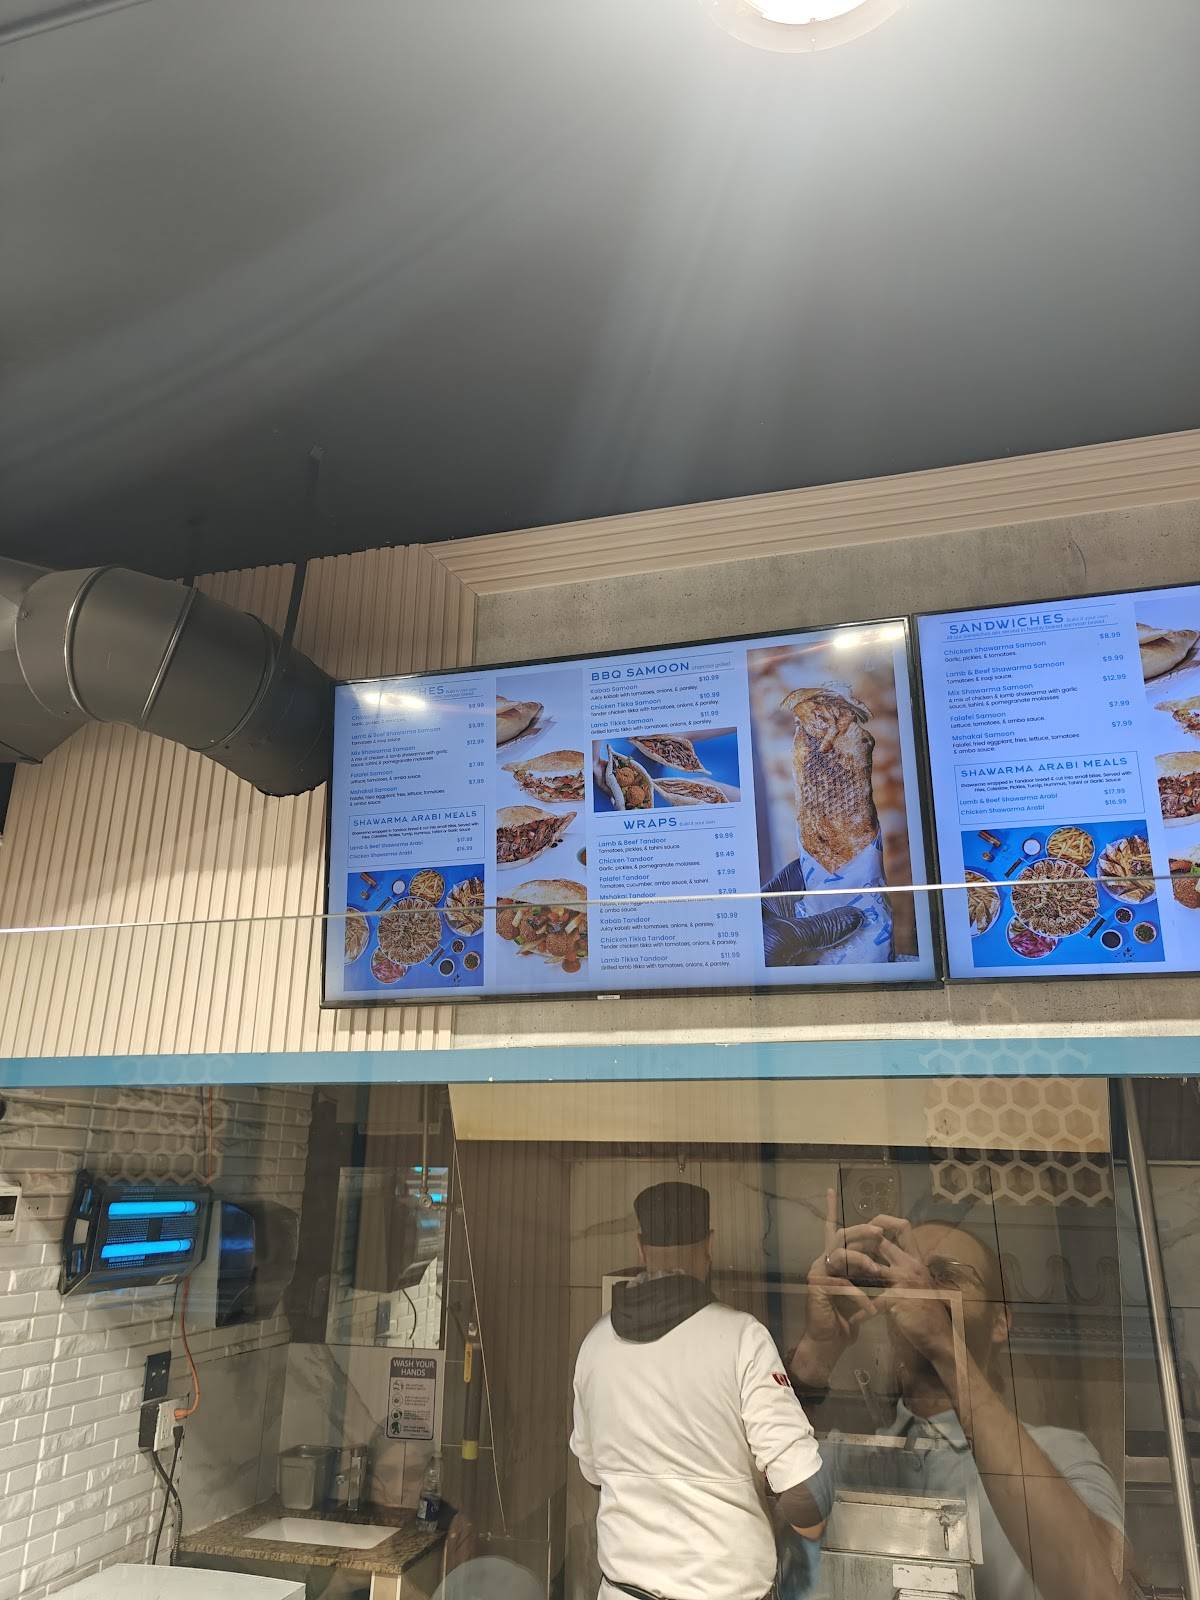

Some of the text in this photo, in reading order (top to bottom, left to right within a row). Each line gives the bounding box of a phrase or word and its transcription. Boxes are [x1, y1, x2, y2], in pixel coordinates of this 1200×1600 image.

[950, 613, 1064, 635] SANDWICHES
[591, 662, 689, 681] BBQ SAMOON
[961, 758, 1127, 777] SHAWARMA ARABI MEALS
[353, 816, 408, 827] SHAWARMA
[411, 813, 441, 822] ARABI
[445, 810, 477, 819] MEALS
[623, 817, 678, 830] WRAPS
[393, 1360, 435, 1369] WASH YOUR
[401, 1368, 426, 1377] HANDS
